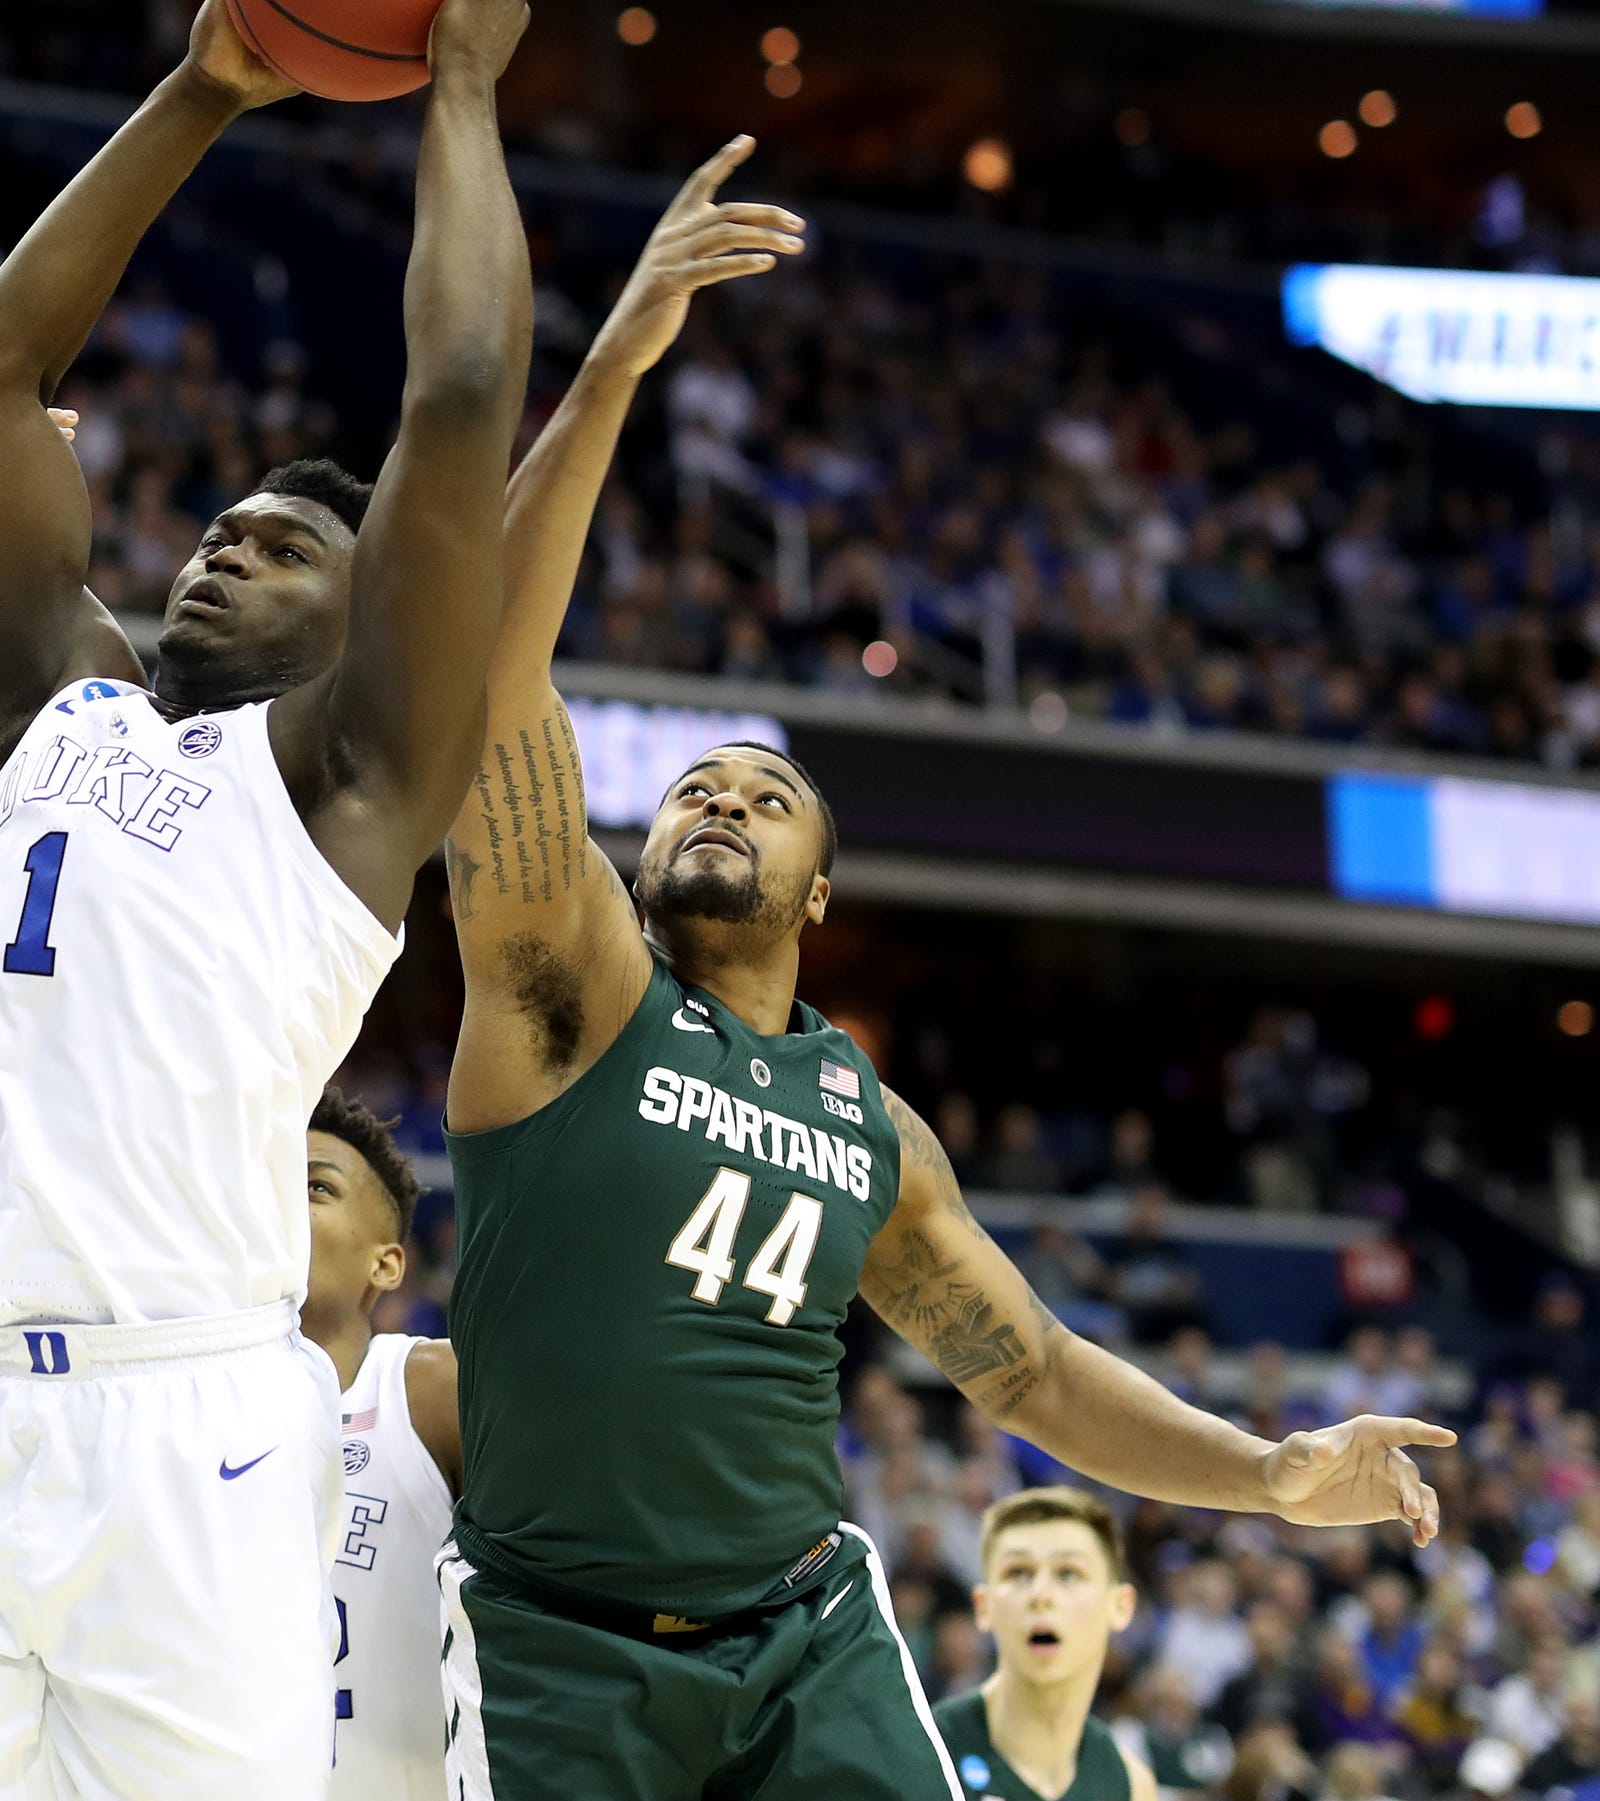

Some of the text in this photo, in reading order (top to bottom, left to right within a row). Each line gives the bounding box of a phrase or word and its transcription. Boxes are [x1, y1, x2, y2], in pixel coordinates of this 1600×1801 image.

[541, 719, 554, 749] heart
[548, 751, 563, 771] and
[553, 773, 565, 797] lean
[536, 810, 546, 821] in
[558, 799, 569, 816] not
[538, 823, 551, 838] all
[560, 819, 570, 833] on
[535, 838, 550, 867] your
[556, 833, 570, 862] your
[520, 866, 533, 880] he
[3, 831, 69, 977] 1
[522, 881, 535, 904] will
[638, 1066, 872, 1203] SPARTANS
[664, 1165, 825, 1328] 44
